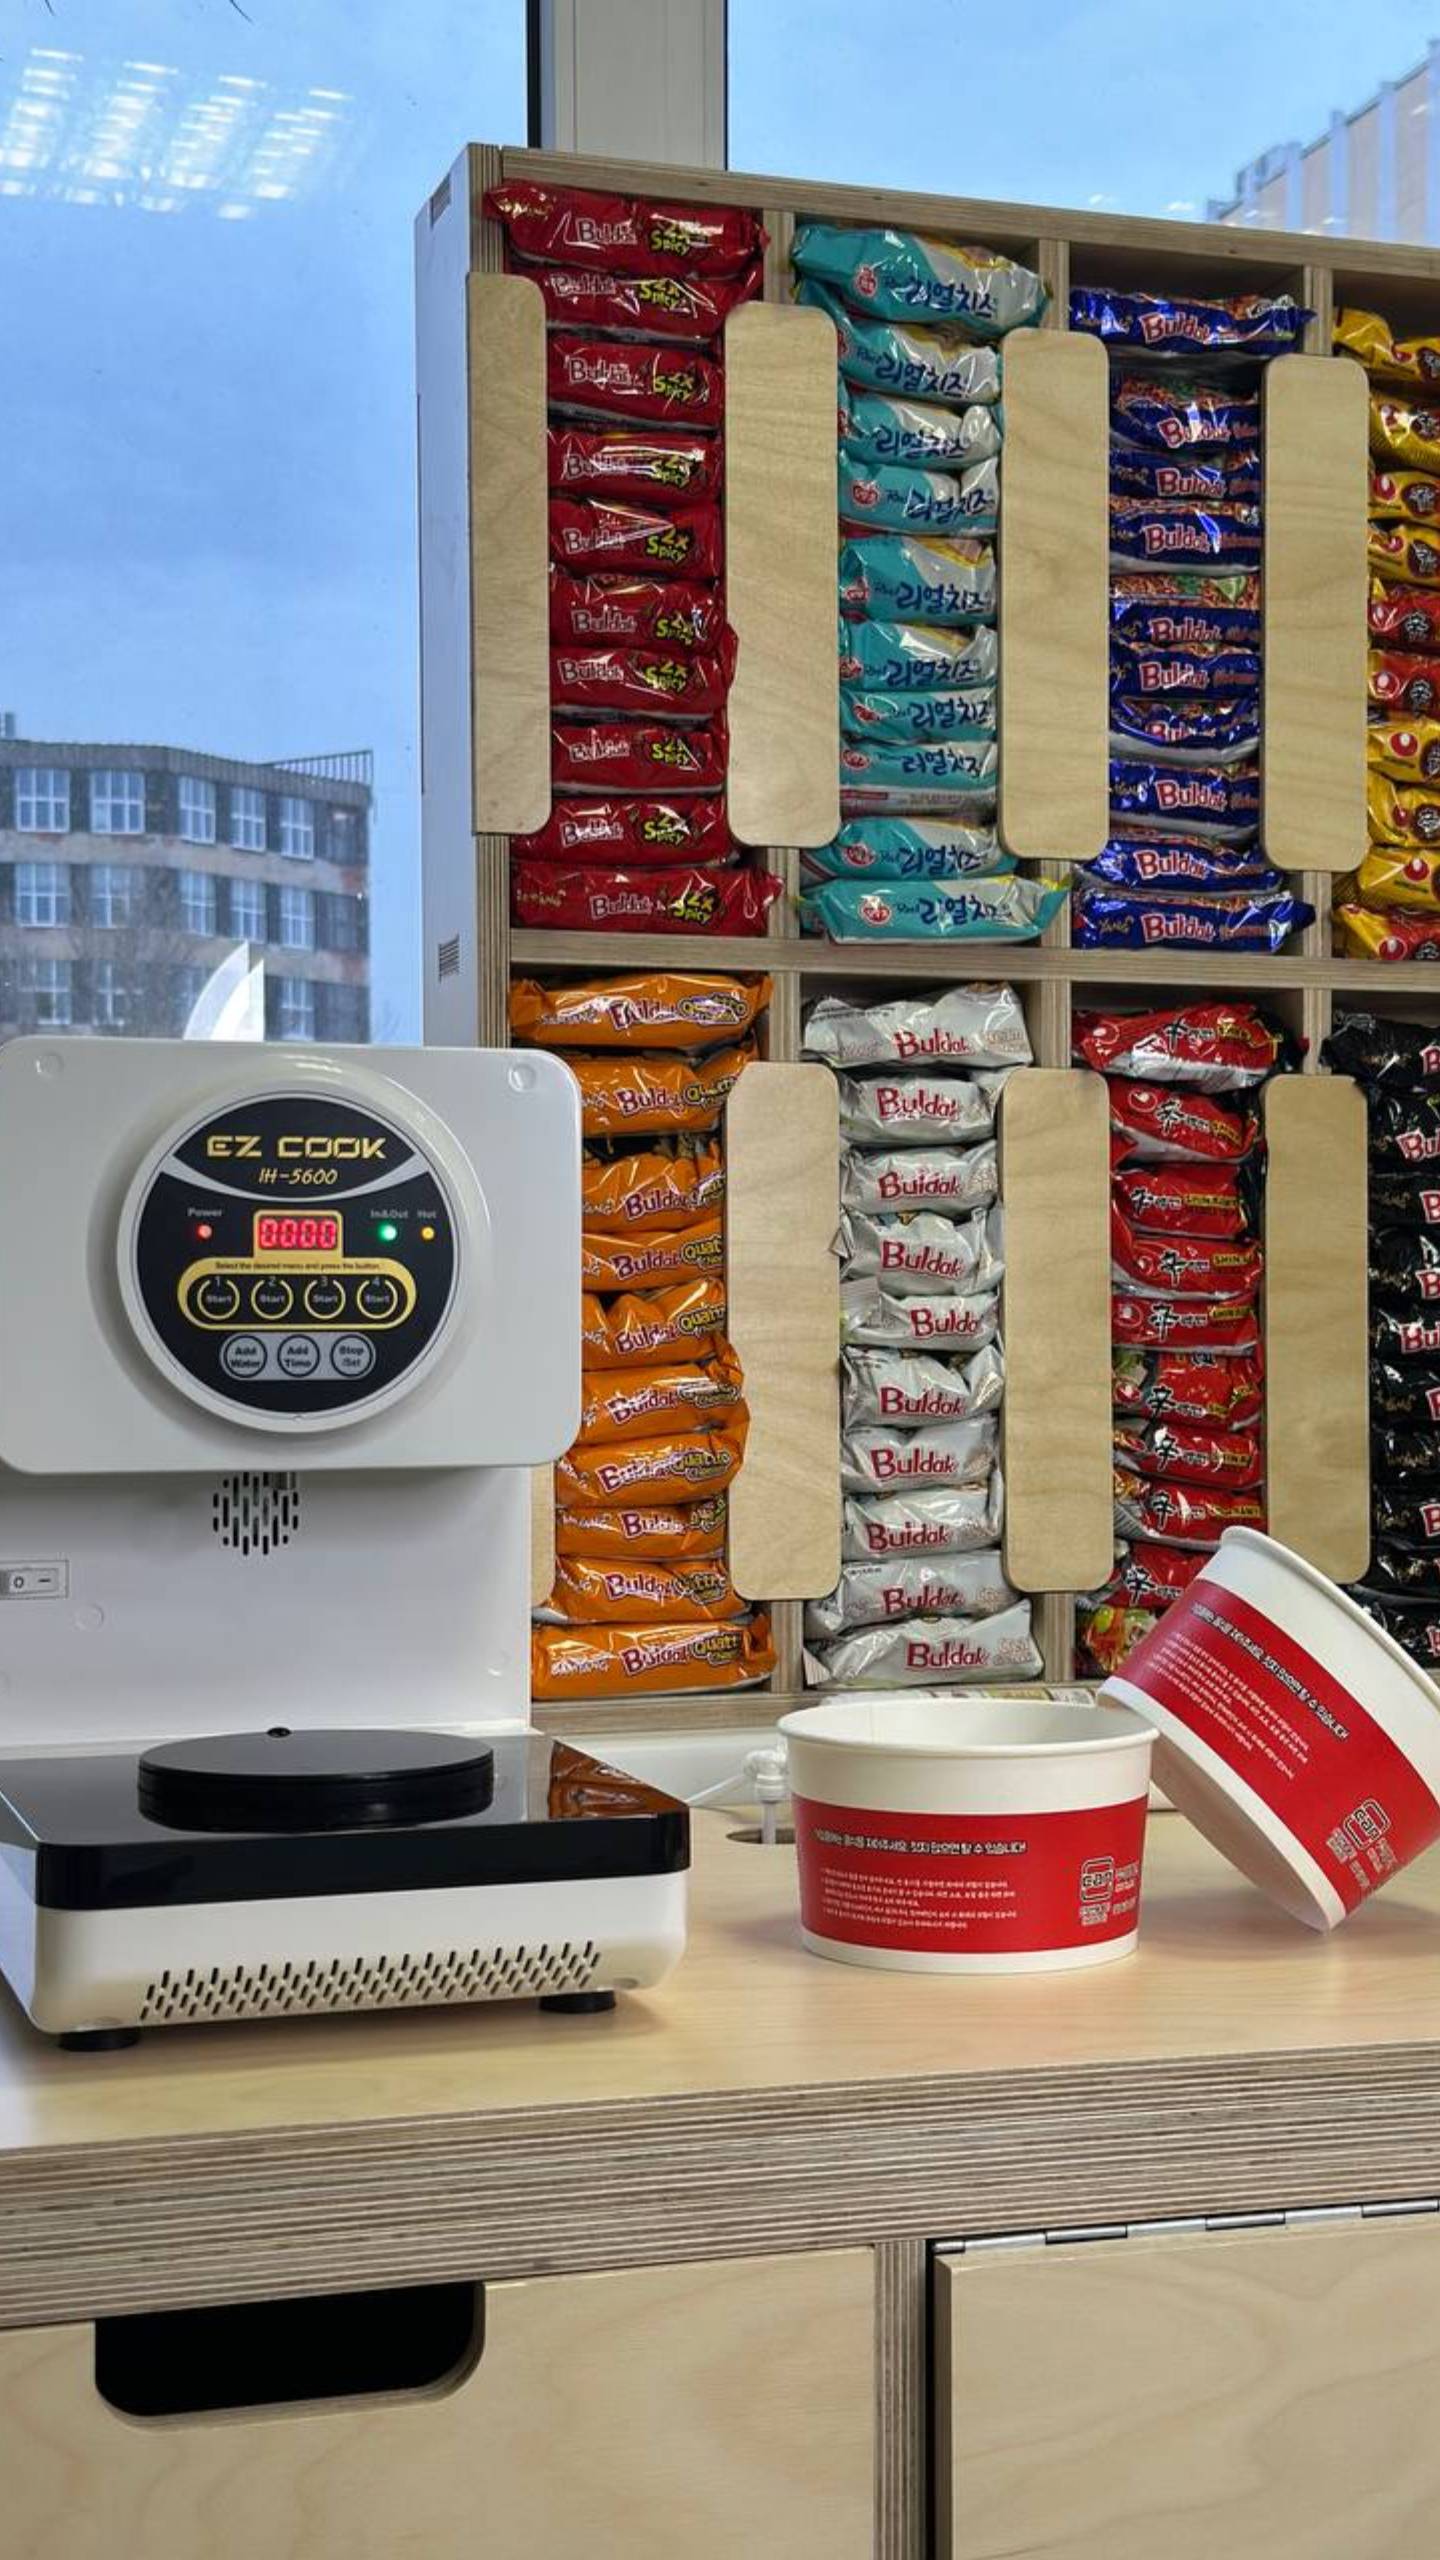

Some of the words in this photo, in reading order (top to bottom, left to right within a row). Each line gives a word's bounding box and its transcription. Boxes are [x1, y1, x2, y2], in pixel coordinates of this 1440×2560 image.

[875, 353, 966, 398] 리얼치즈
[895, 582, 986, 614] 리얼치즈
[886, 659, 980, 687] 리얼치즈
[910, 697, 993, 729] 리얼치즈
[1155, 778, 1230, 813] Buldak
[1133, 849, 1211, 881] Buldak
[1140, 913, 1217, 943] Buldak
[894, 1028, 970, 1060] Buldak
[876, 1087, 960, 1118] Buldak
[207, 1135, 262, 1158] EZ
[277, 1136, 387, 1160] COOK
[258, 1167, 339, 1186] IH-5600
[187, 1207, 223, 1218] Power
[417, 1209, 437, 1220] Hot
[260, 1218, 337, 1249] 0000
[215, 1262, 239, 1271] Select
[253, 1262, 282, 1271] desired
[881, 1240, 964, 1277] Buldak
[215, 1276, 221, 1287] 1
[268, 1276, 277, 1287] 2
[321, 1276, 329, 1287] 3
[372, 1276, 381, 1287] 4
[206, 1294, 233, 1303] Start
[259, 1294, 286, 1303] Start
[313, 1294, 339, 1303] Start
[365, 1294, 390, 1303] Start
[909, 1308, 983, 1338] Bulda
[235, 1345, 257, 1356] Add
[287, 1345, 308, 1356] Add
[338, 1346, 364, 1356] Stop
[230, 1359, 261, 1369] Water
[284, 1359, 312, 1368] Time
[879, 1386, 965, 1416] Buldak
[870, 1447, 958, 1479] Buldak
[866, 1521, 952, 1552] Buldak
[905, 1641, 989, 1670] Buldak
